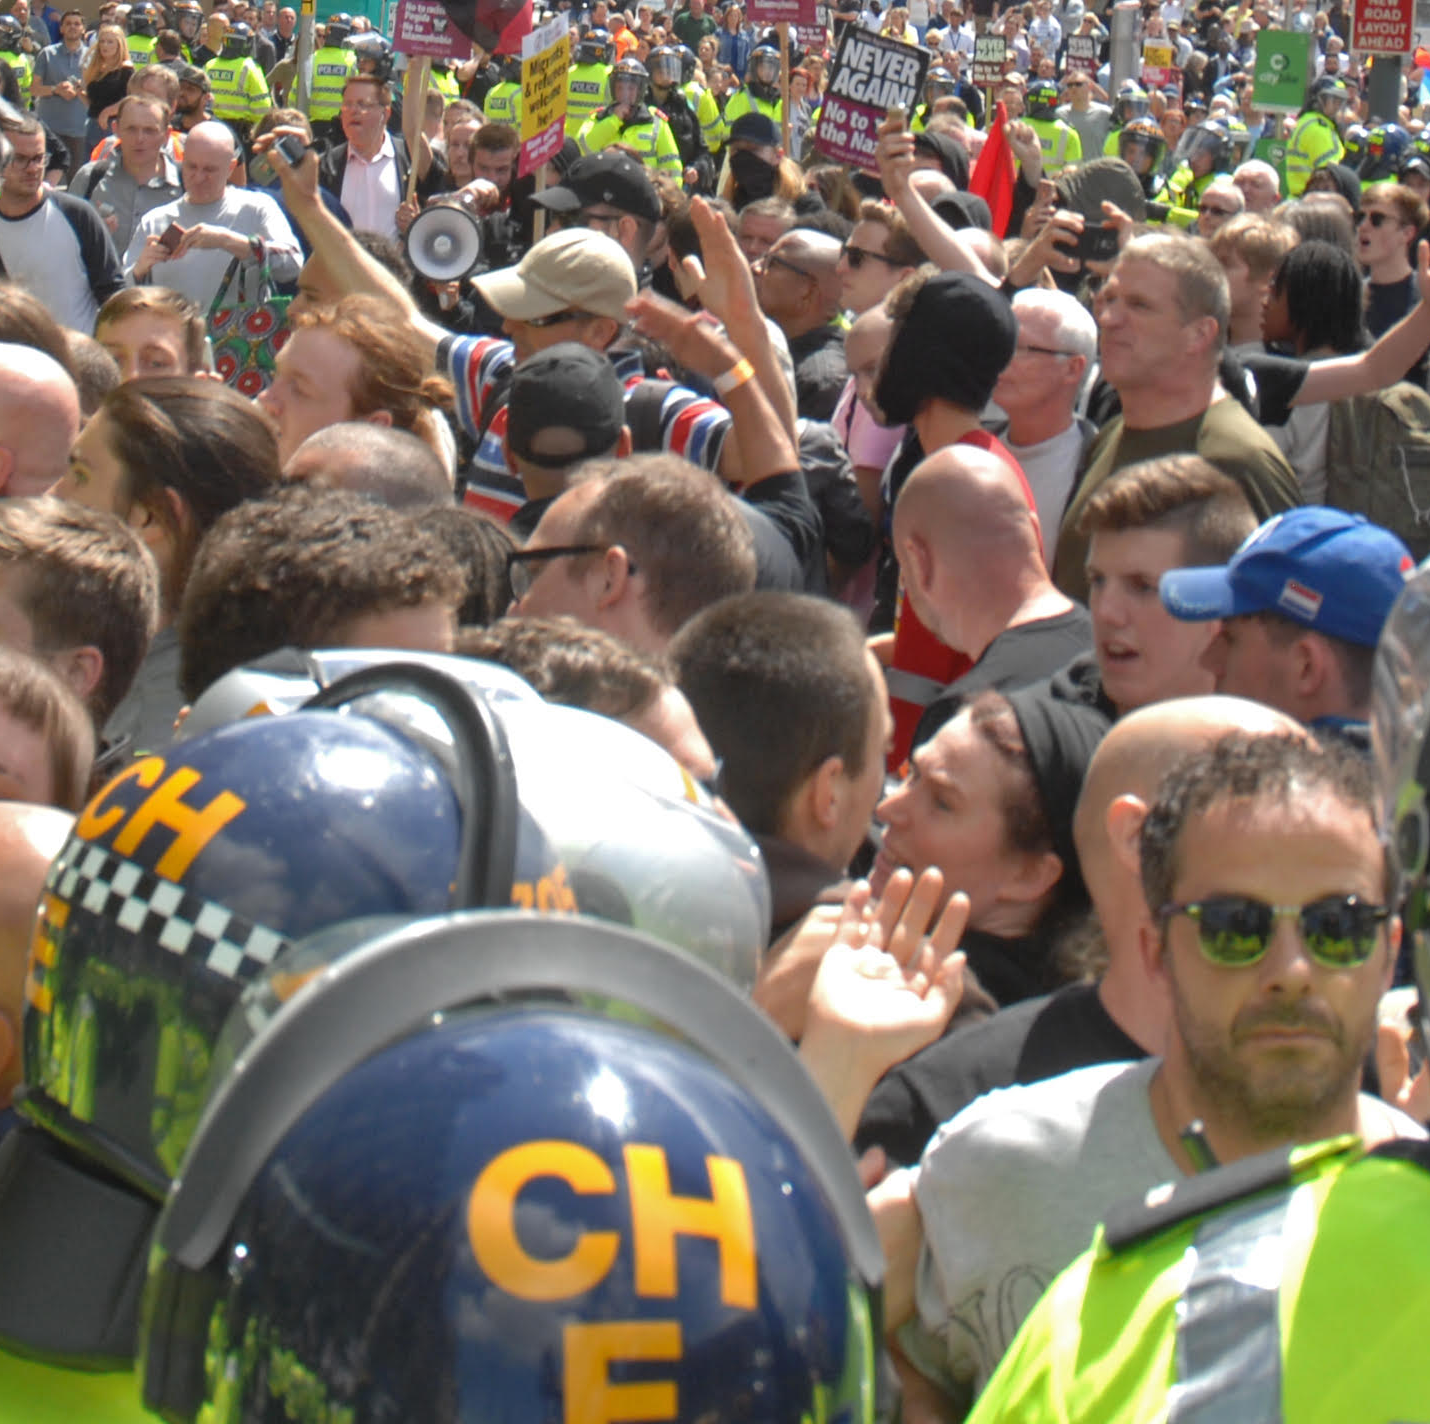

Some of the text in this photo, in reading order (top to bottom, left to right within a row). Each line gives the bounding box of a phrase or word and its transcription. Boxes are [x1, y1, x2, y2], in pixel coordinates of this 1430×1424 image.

[1357, 21, 1407, 35] LAYOUT
[1364, 7, 1402, 21] ROAD
[1358, 35, 1404, 49] AHEAD
[318, 64, 347, 75] POLICE
[841, 38, 921, 86] NEVER
[571, 81, 599, 93] POLICE
[831, 67, 917, 114] AGAIN!
[824, 100, 869, 130] No to
[820, 122, 878, 155] the Naz
[74, 754, 247, 883] CH
[467, 1138, 758, 1311] CH
